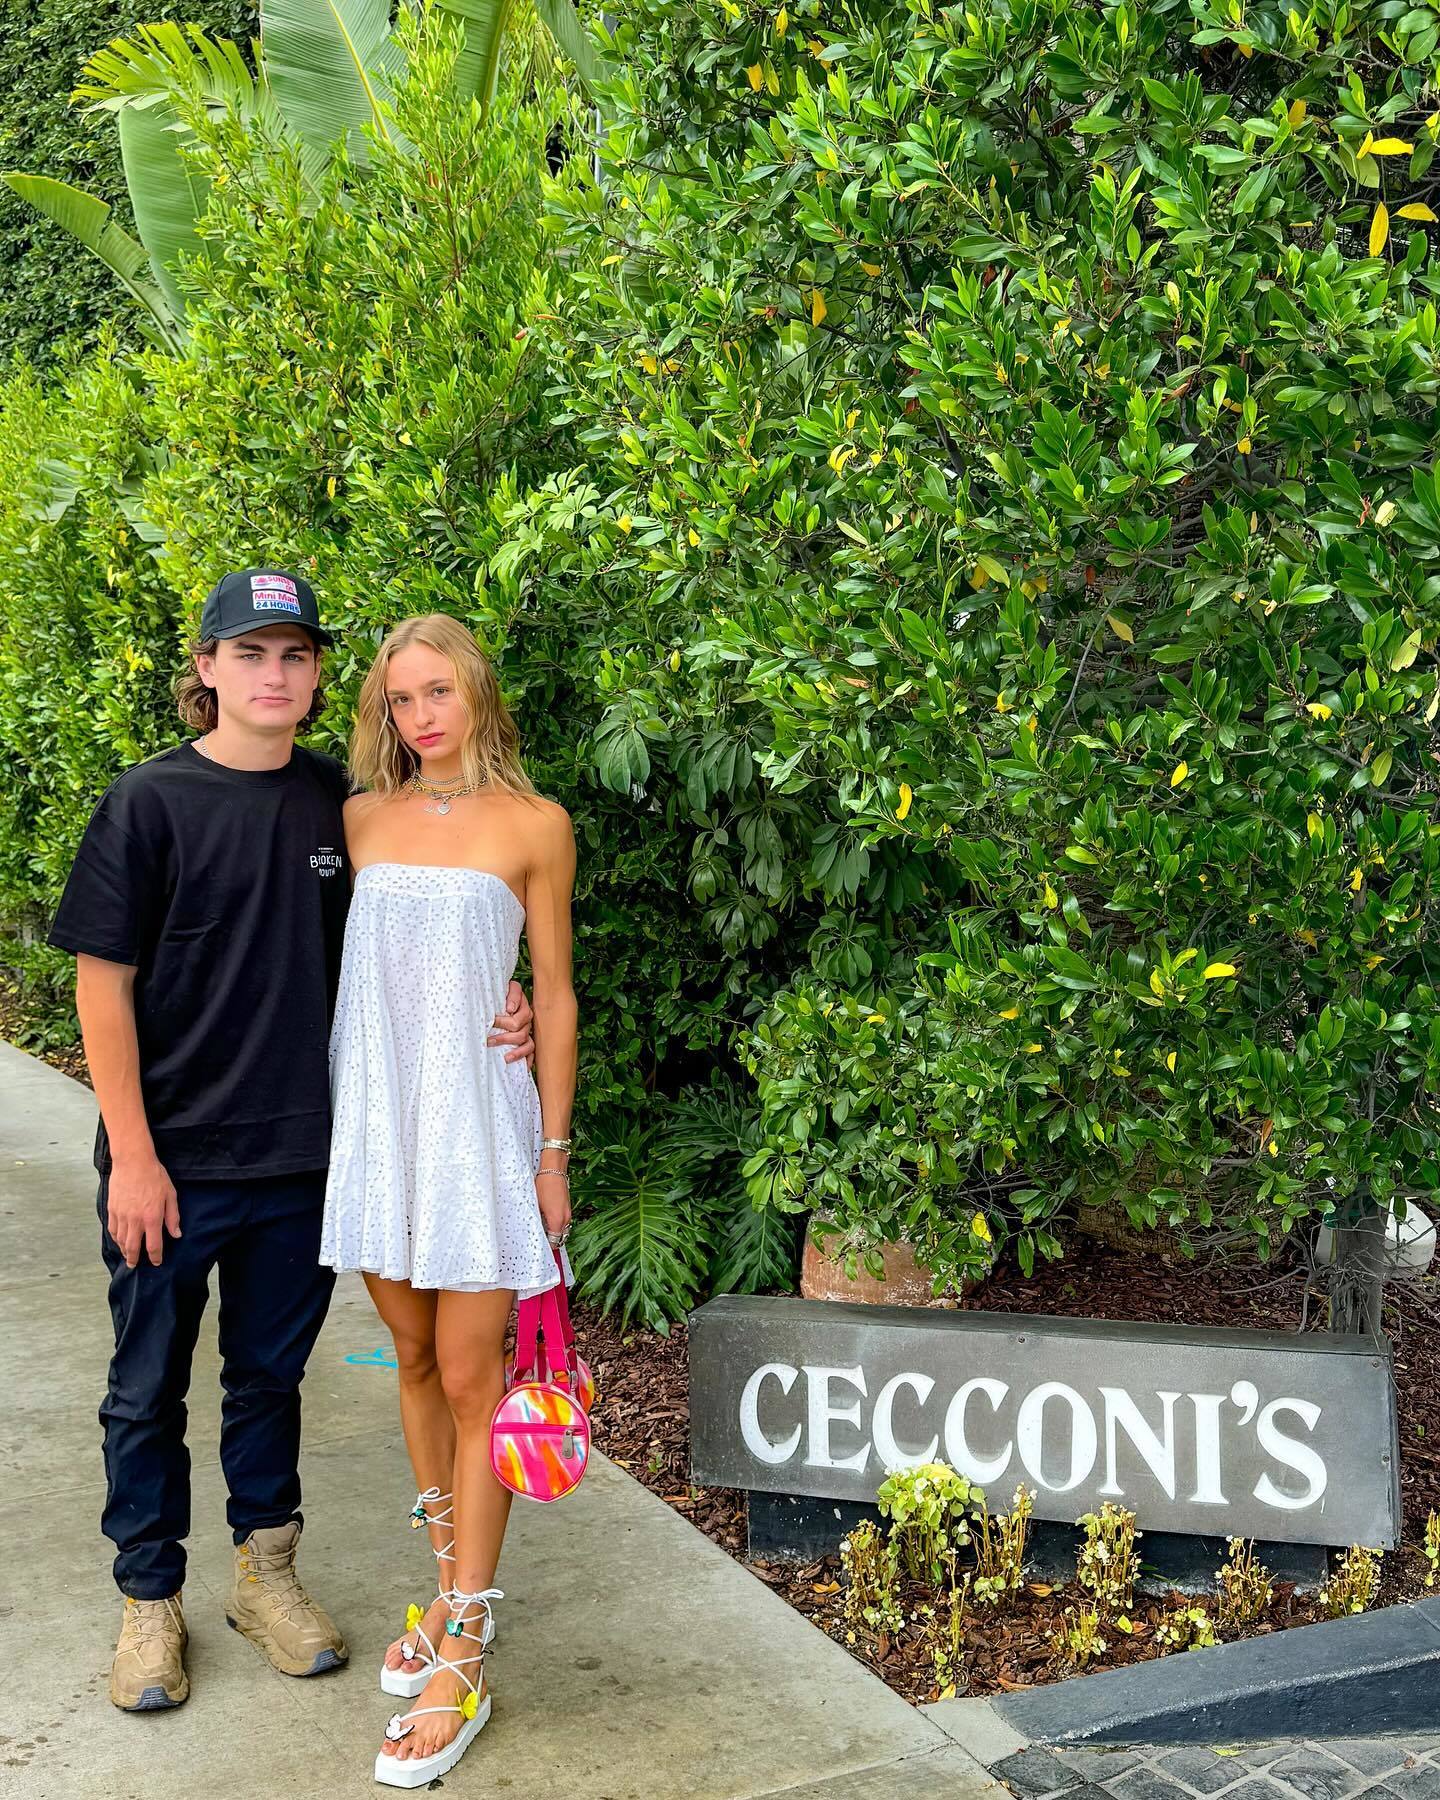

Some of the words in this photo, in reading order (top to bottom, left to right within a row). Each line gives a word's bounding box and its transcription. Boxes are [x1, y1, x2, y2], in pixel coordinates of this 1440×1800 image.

[254, 592, 276, 600] Mini
[278, 592, 298, 604] Mart
[255, 601, 269, 609] 24
[270, 601, 300, 614] HOURS
[309, 855, 342, 868] BROKEN
[739, 1362, 1328, 1509] CECCONI'S
